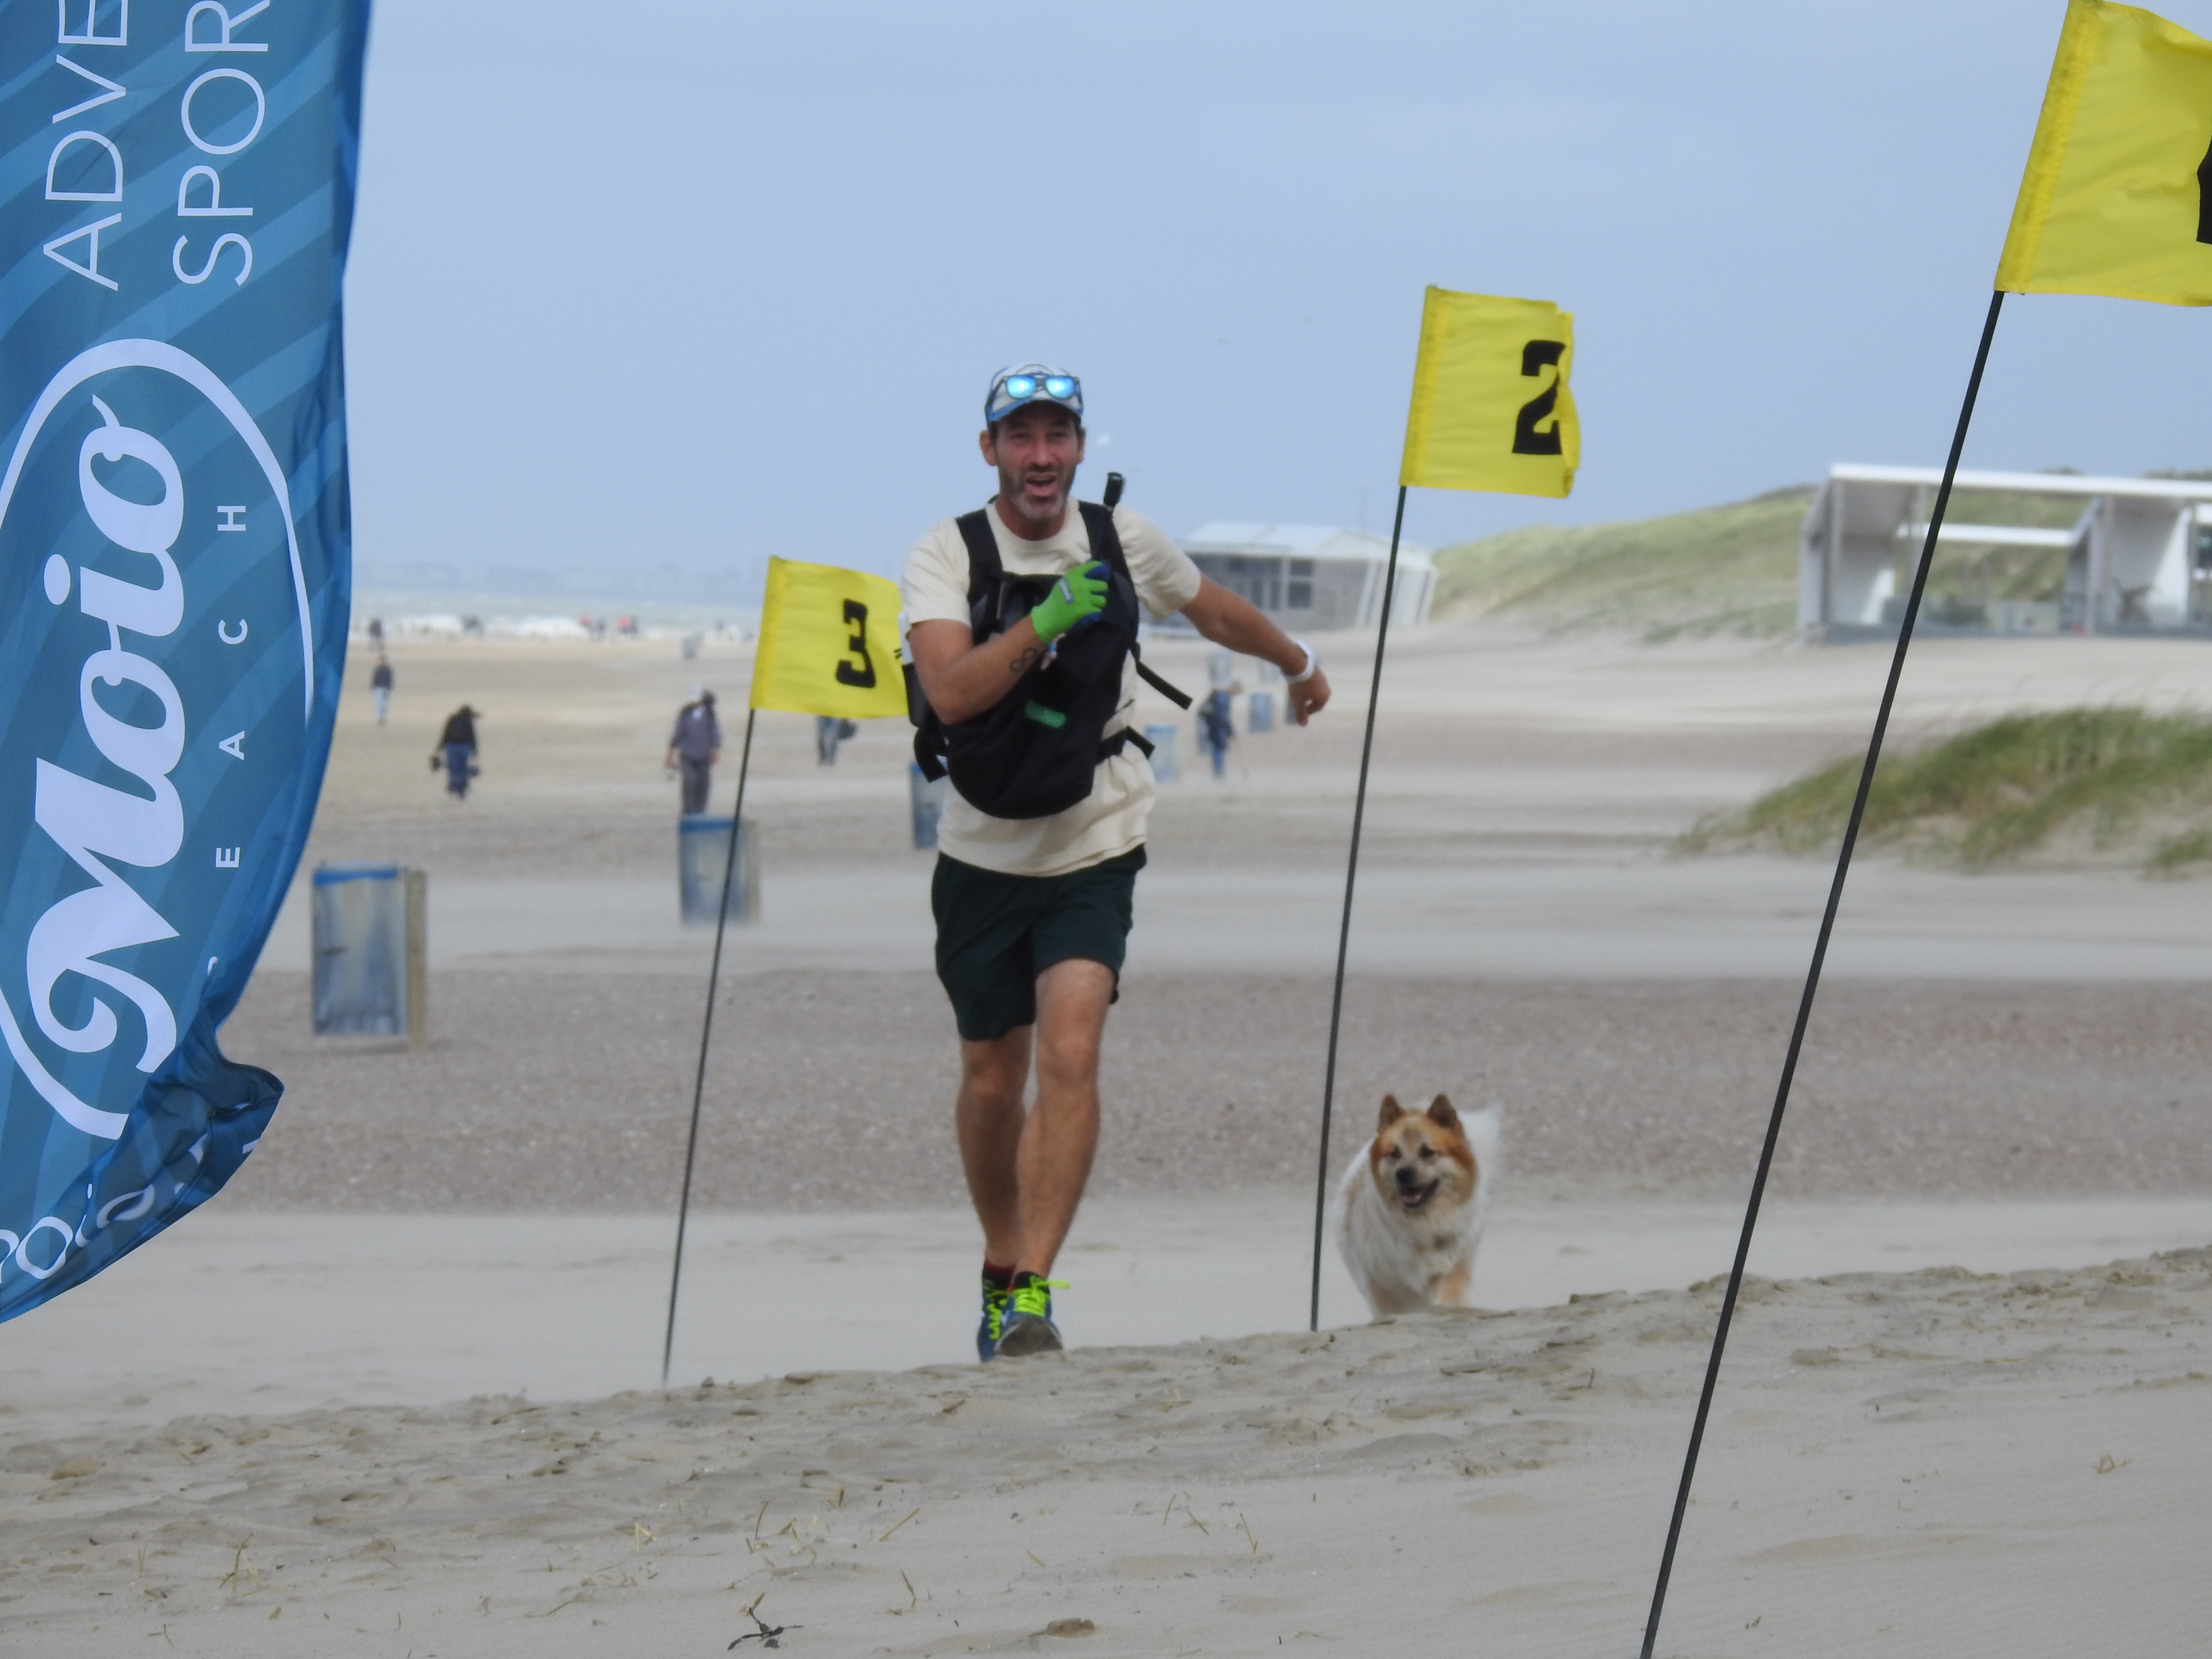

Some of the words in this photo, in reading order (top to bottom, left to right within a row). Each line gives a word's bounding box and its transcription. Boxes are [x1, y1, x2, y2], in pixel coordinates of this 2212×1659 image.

[44, 0, 128, 291] ADVE
[172, 0, 270, 286] SPOR
[1512, 339, 1566, 456] 2
[26, 394, 186, 1073] Moio
[207, 505, 248, 975] EACH
[835, 598, 876, 688] 3
